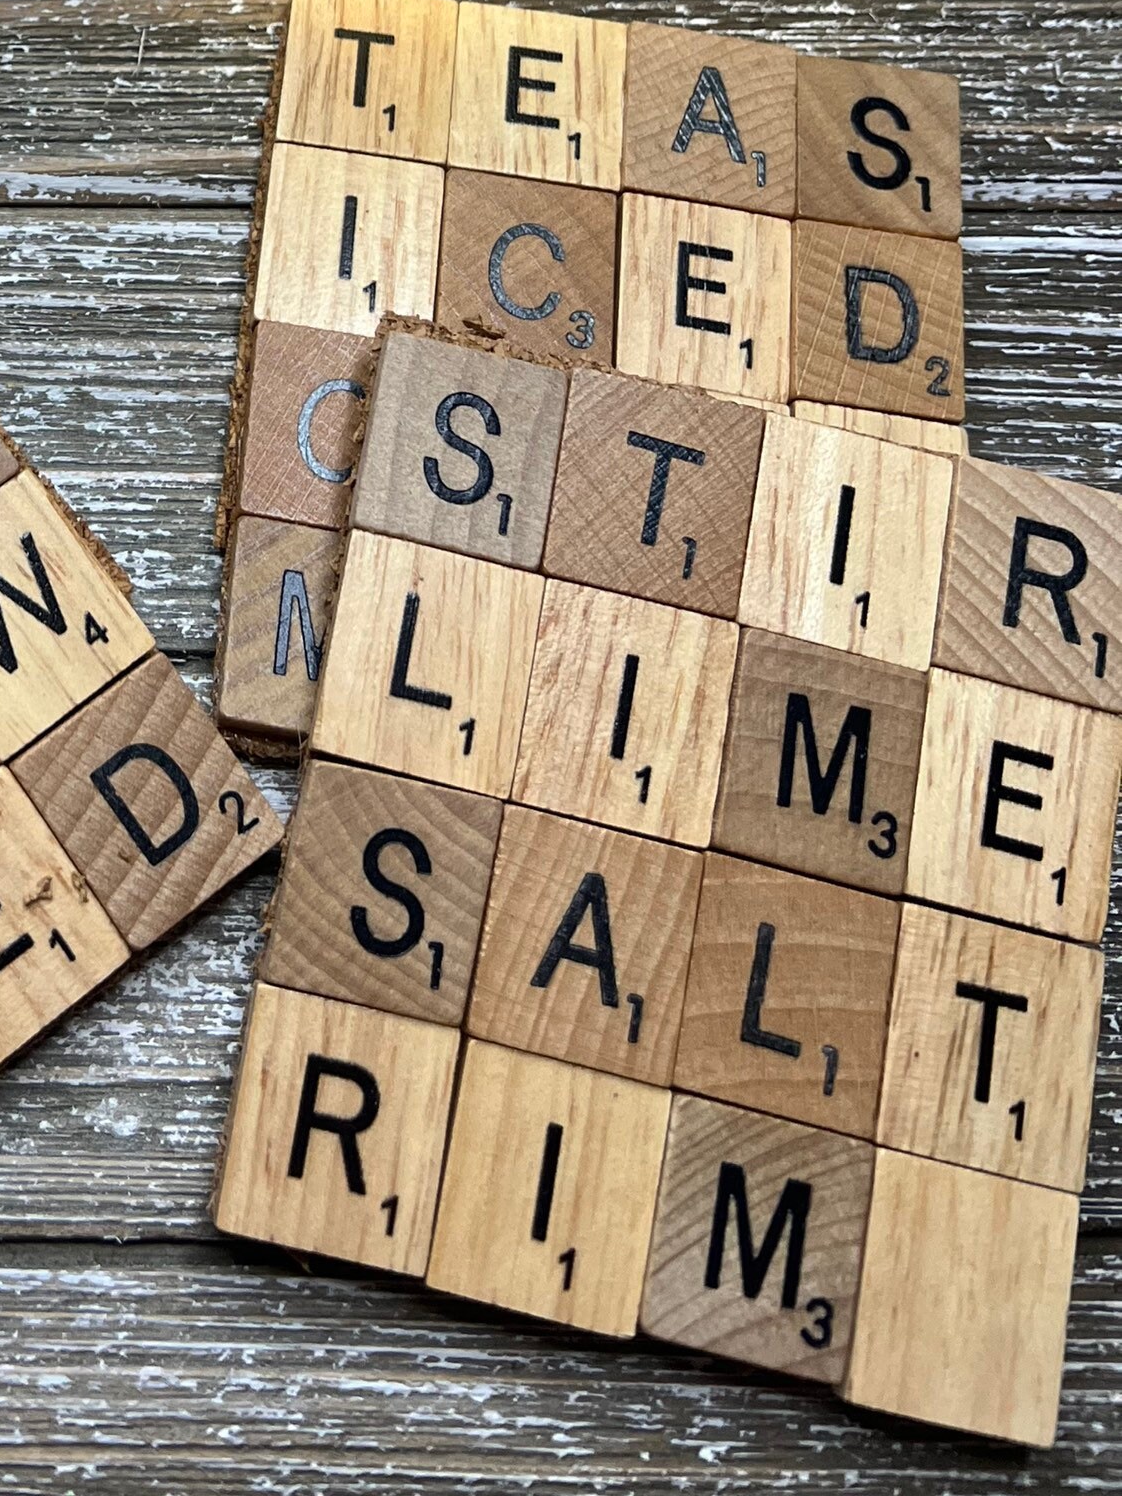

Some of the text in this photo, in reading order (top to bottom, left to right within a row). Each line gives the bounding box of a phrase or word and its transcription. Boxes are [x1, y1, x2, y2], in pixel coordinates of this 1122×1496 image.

[335, 29, 911, 190] TEAS
[382, 102, 932, 212] 1 1 1 1
[339, 195, 920, 364] ICED
[362, 280, 951, 396] 1 3 1 2
[423, 392, 1087, 645] STIR
[497, 493, 1108, 679] 1 1 1 1
[82, 608, 111, 648] 4
[391, 592, 1053, 861] LIME
[460, 717, 1067, 903] 1 1 3 1
[48, 928, 76, 962] 1
[219, 790, 257, 834] 2
[350, 828, 1027, 1104] SALT
[428, 939, 1027, 1141] 1 1 1 1
[287, 1054, 813, 1307] RIM
[381, 1196, 833, 1349] 1 1 3
